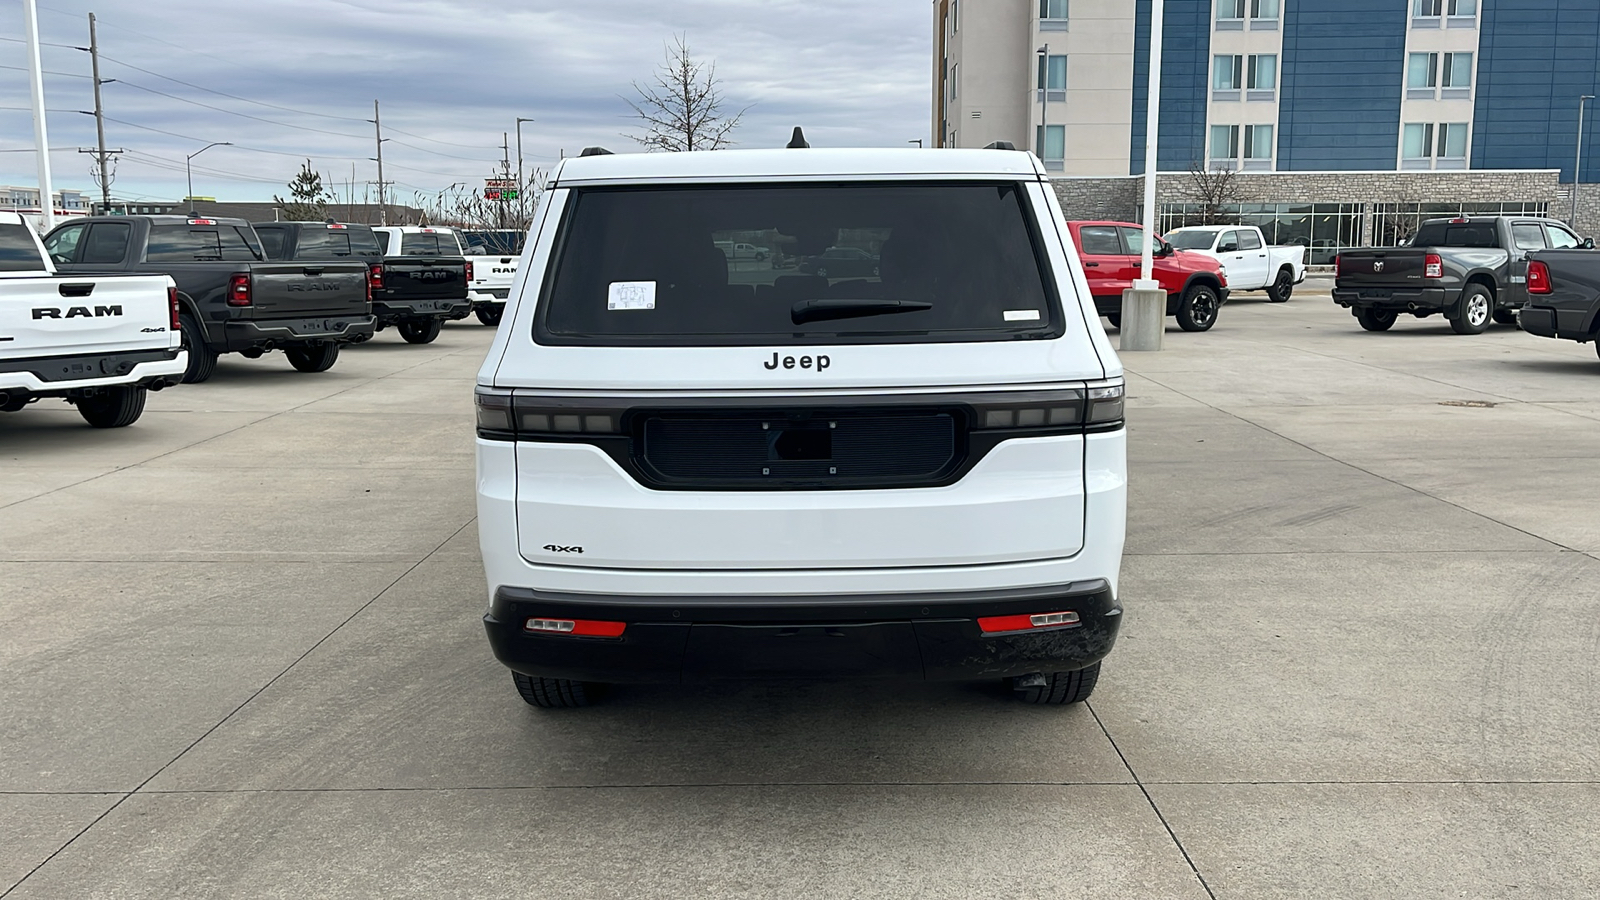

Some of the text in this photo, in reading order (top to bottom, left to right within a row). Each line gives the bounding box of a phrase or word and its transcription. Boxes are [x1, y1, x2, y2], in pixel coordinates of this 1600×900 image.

[409, 271, 447, 279] RAM
[287, 282, 340, 292] RAM
[31, 305, 123, 320] RAM
[763, 352, 831, 372] Jeep
[542, 544, 585, 554] 4x4
